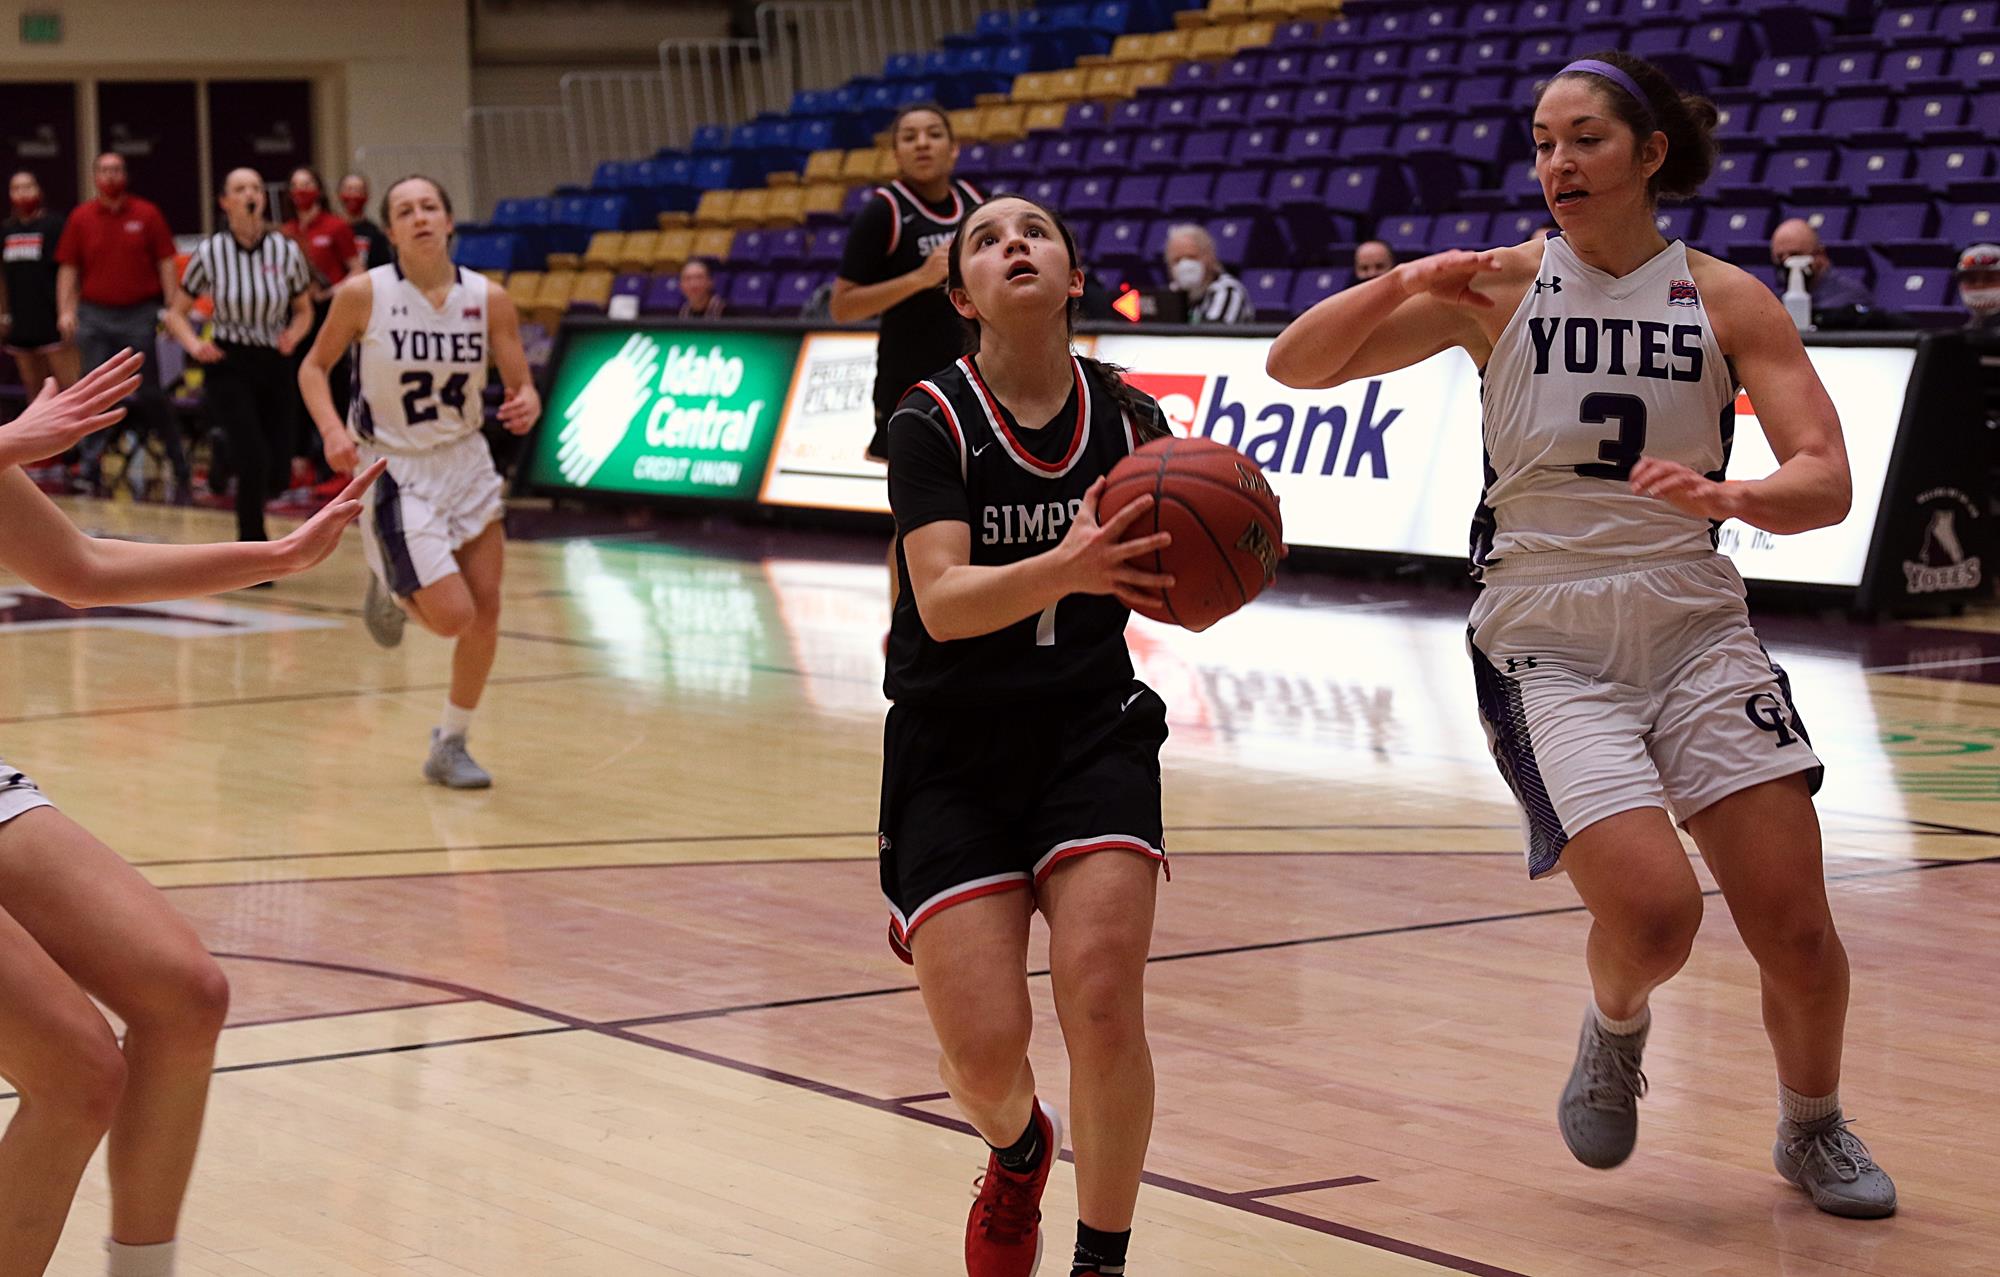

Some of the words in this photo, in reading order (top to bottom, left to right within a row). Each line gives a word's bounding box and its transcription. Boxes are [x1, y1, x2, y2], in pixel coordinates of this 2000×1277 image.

[390, 329, 482, 363] YOTES
[658, 344, 744, 398] Idaho
[1528, 317, 1704, 383] YOTES
[401, 371, 469, 426] 24
[645, 395, 765, 452] Central
[1574, 392, 1647, 482] 3
[1902, 557, 1982, 594] YOTES
